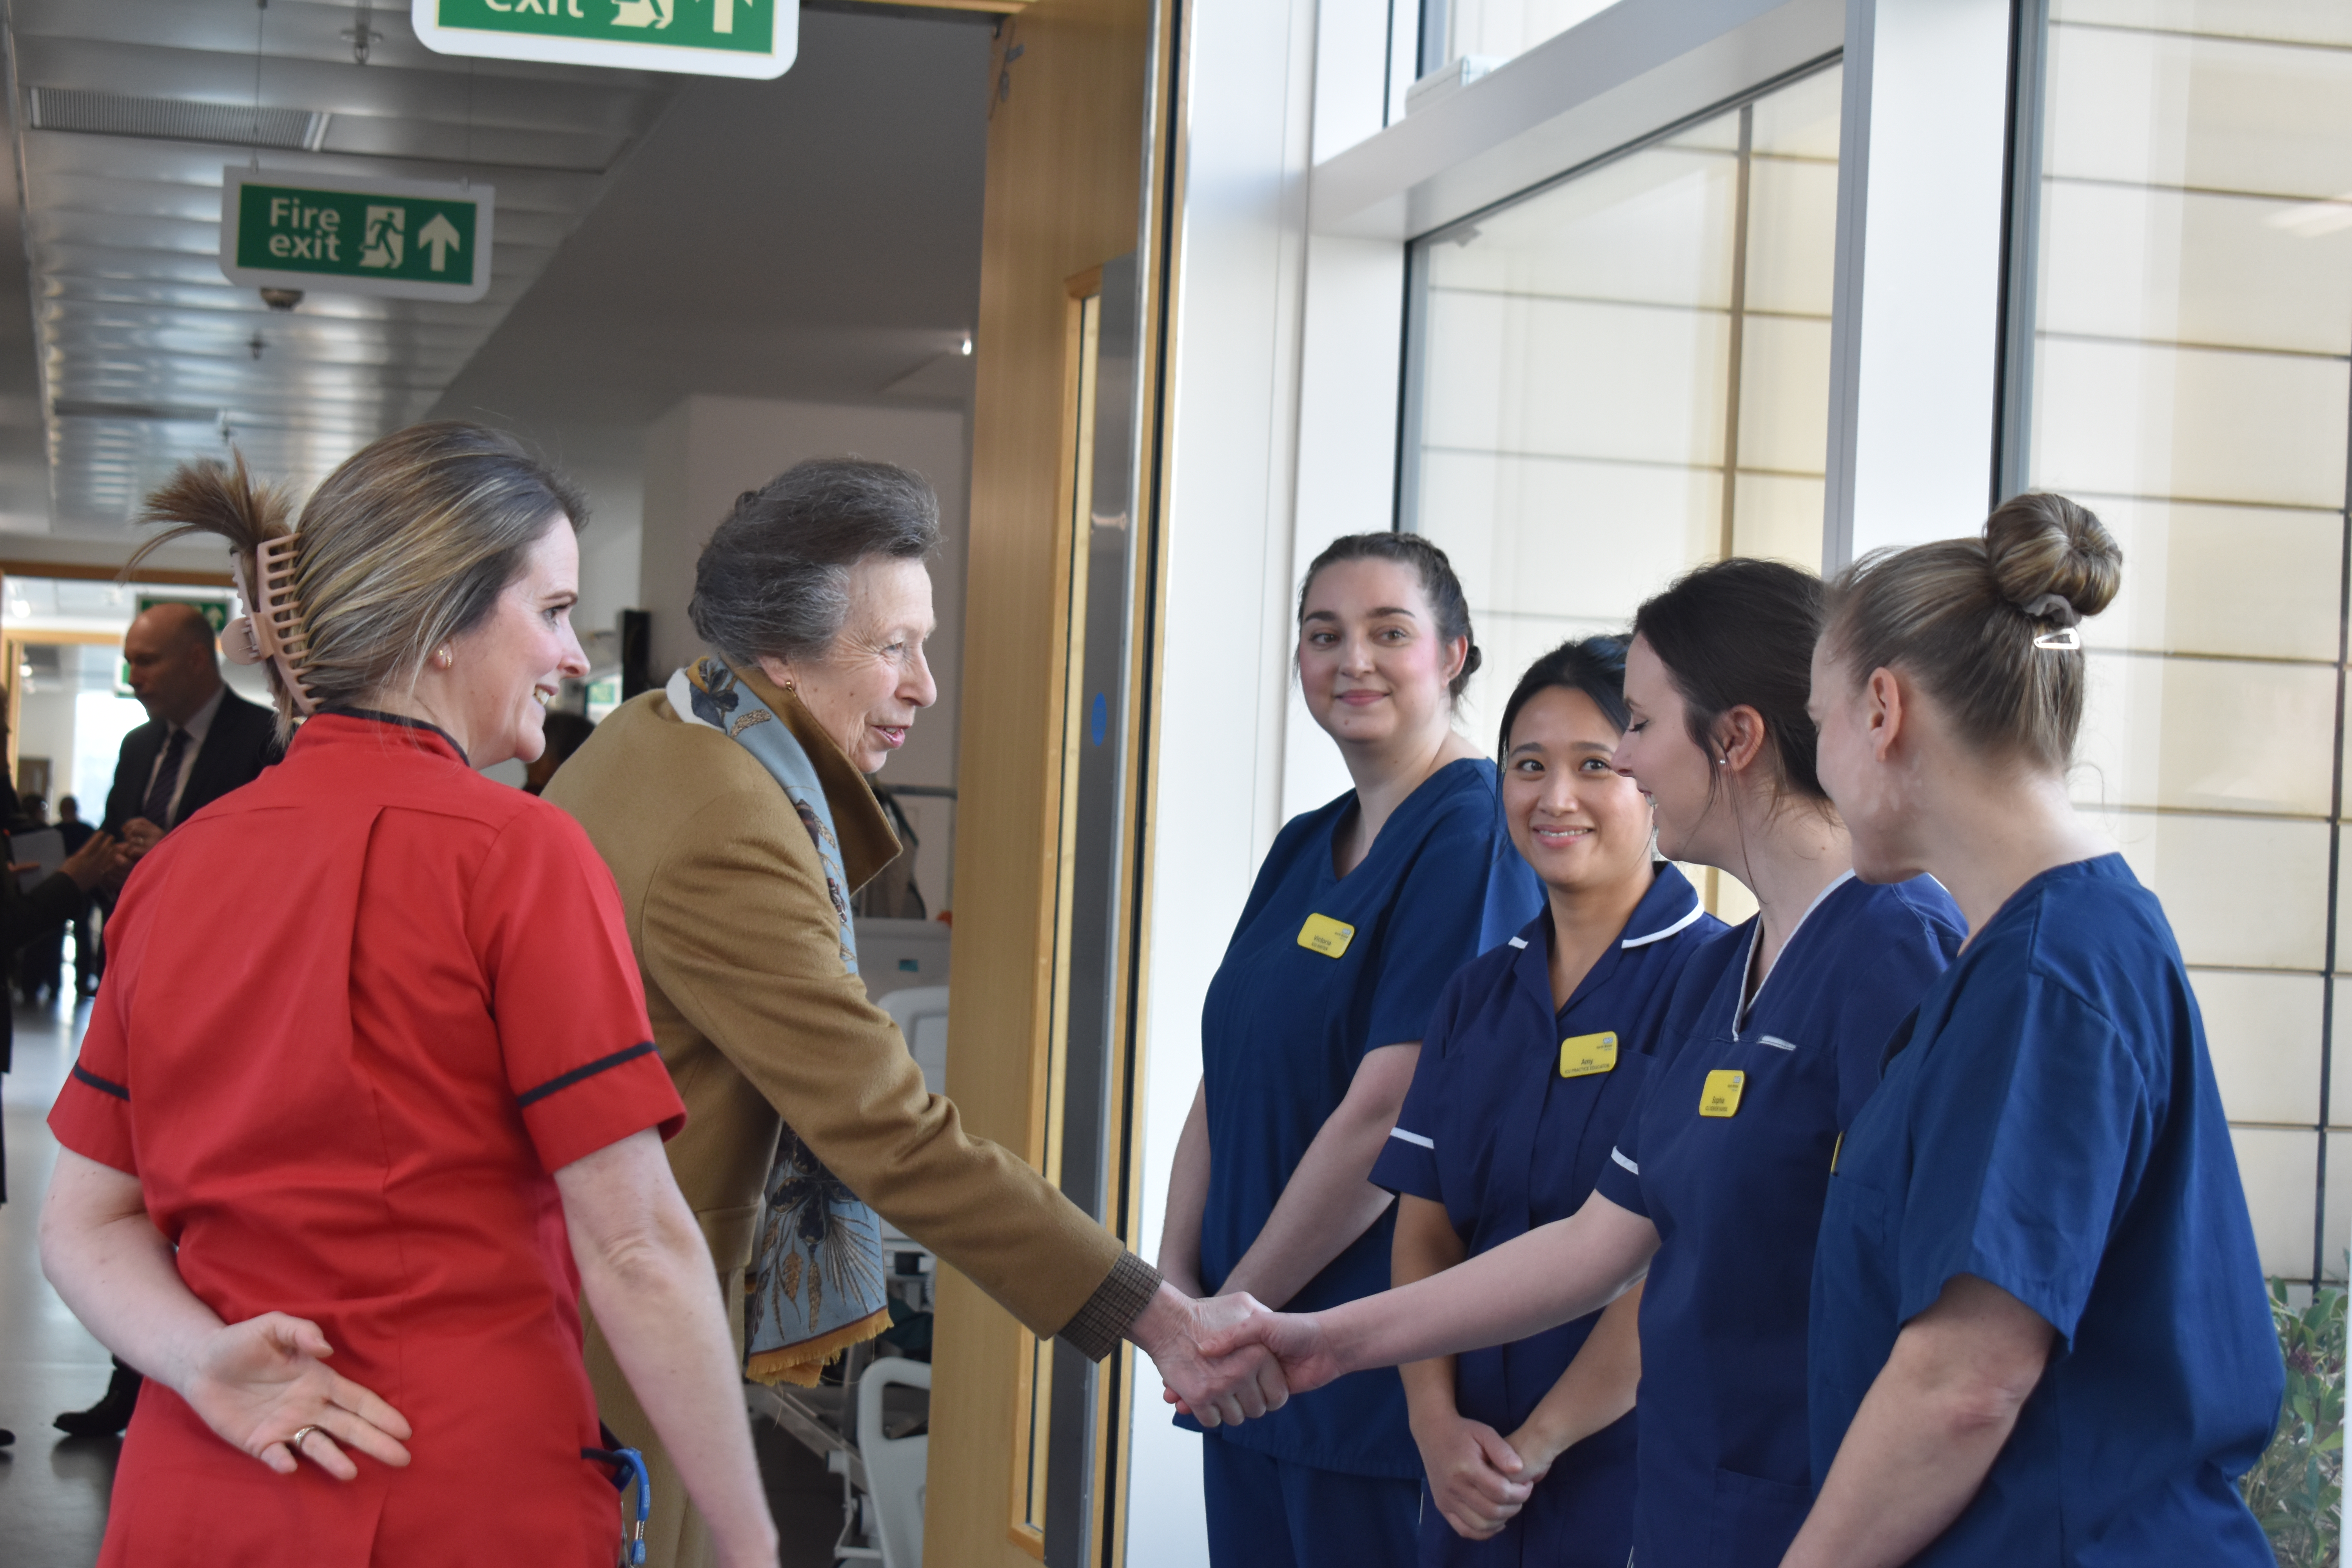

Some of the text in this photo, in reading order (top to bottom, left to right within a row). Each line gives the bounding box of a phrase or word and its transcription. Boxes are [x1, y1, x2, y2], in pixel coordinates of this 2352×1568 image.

[270, 198, 340, 231] Fire
[269, 229, 340, 261] exit
[1314, 935, 1331, 946] Victoria
